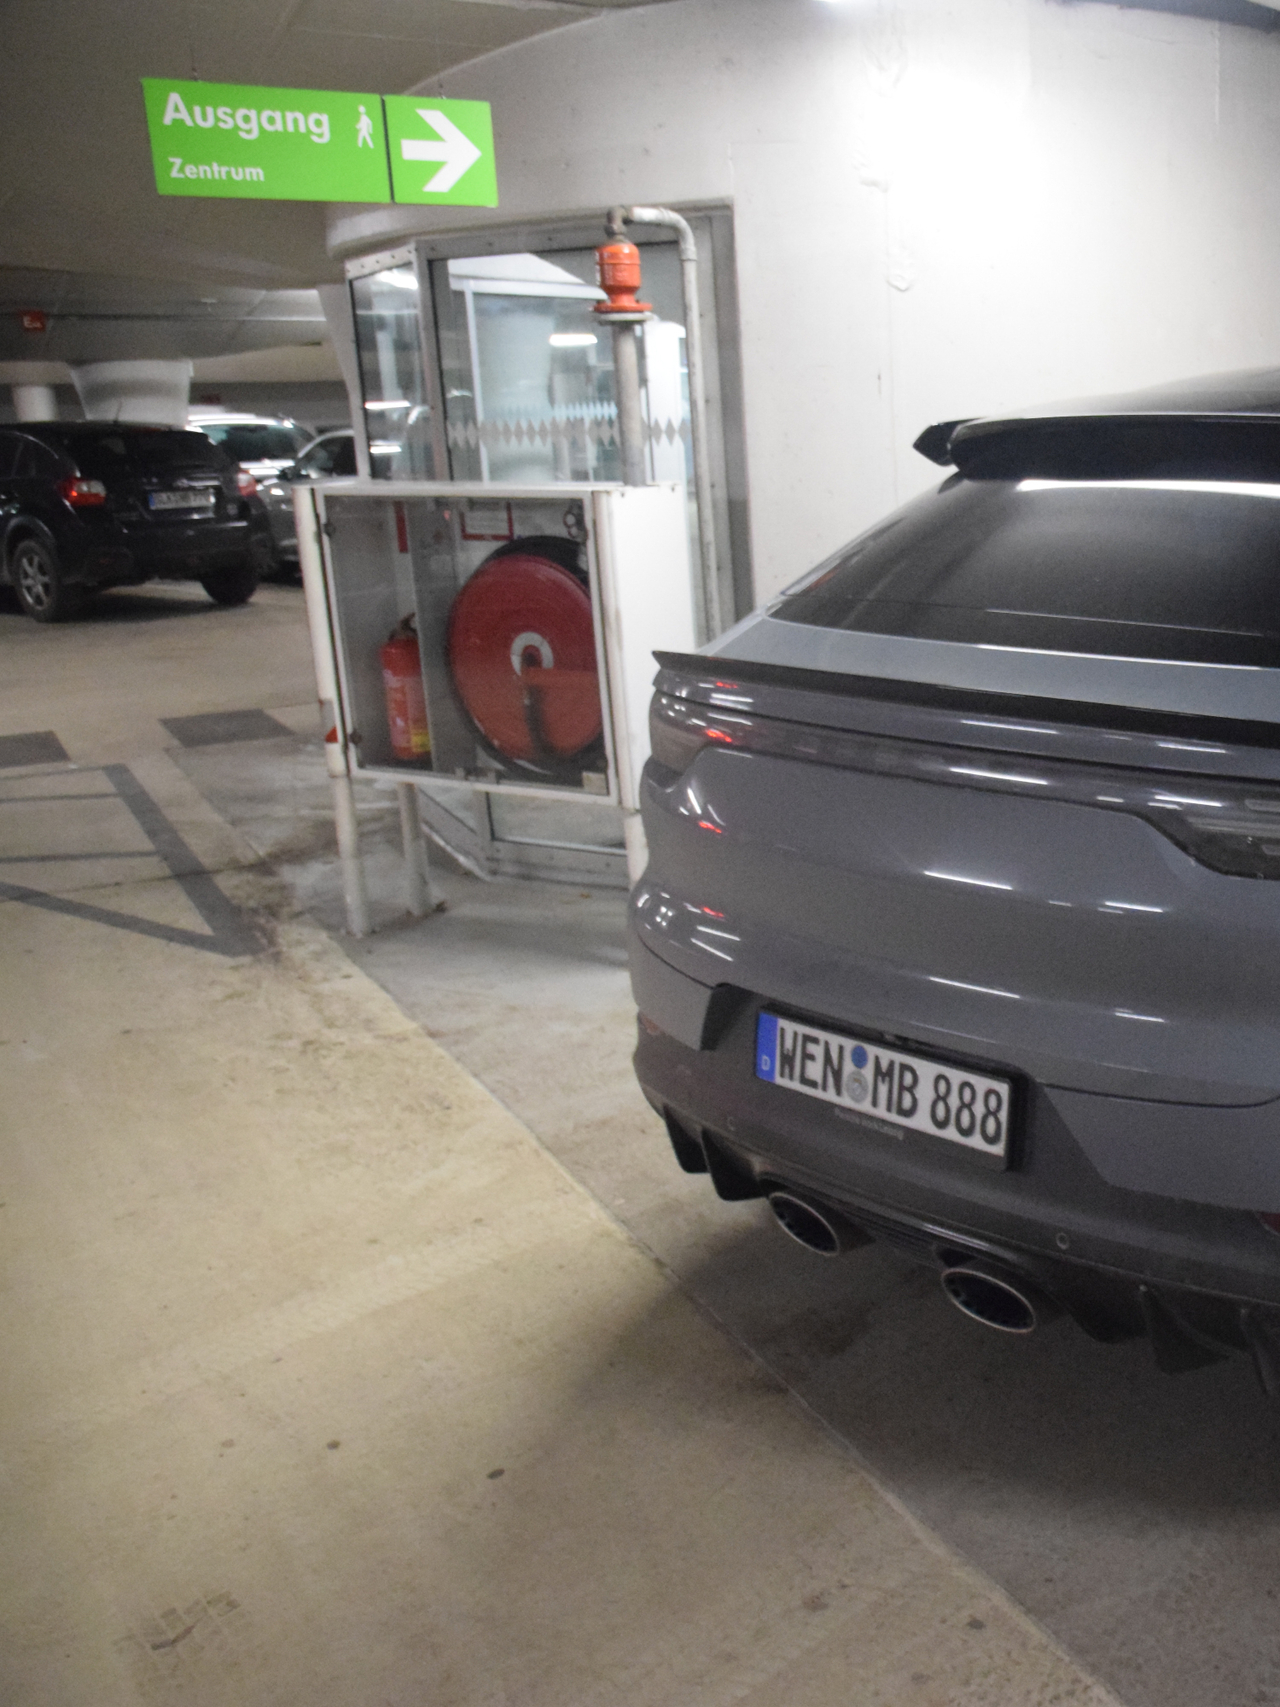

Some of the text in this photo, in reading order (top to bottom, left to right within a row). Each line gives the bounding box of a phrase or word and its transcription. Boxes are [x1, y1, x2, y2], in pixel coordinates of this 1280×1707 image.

[162, 92, 331, 143] Ausgang
[168, 157, 264, 182] Zentrum
[761, 1055, 770, 1070] D
[779, 1027, 844, 1097] WEN
[871, 1055, 919, 1118] MB
[930, 1074, 1002, 1145] 888
